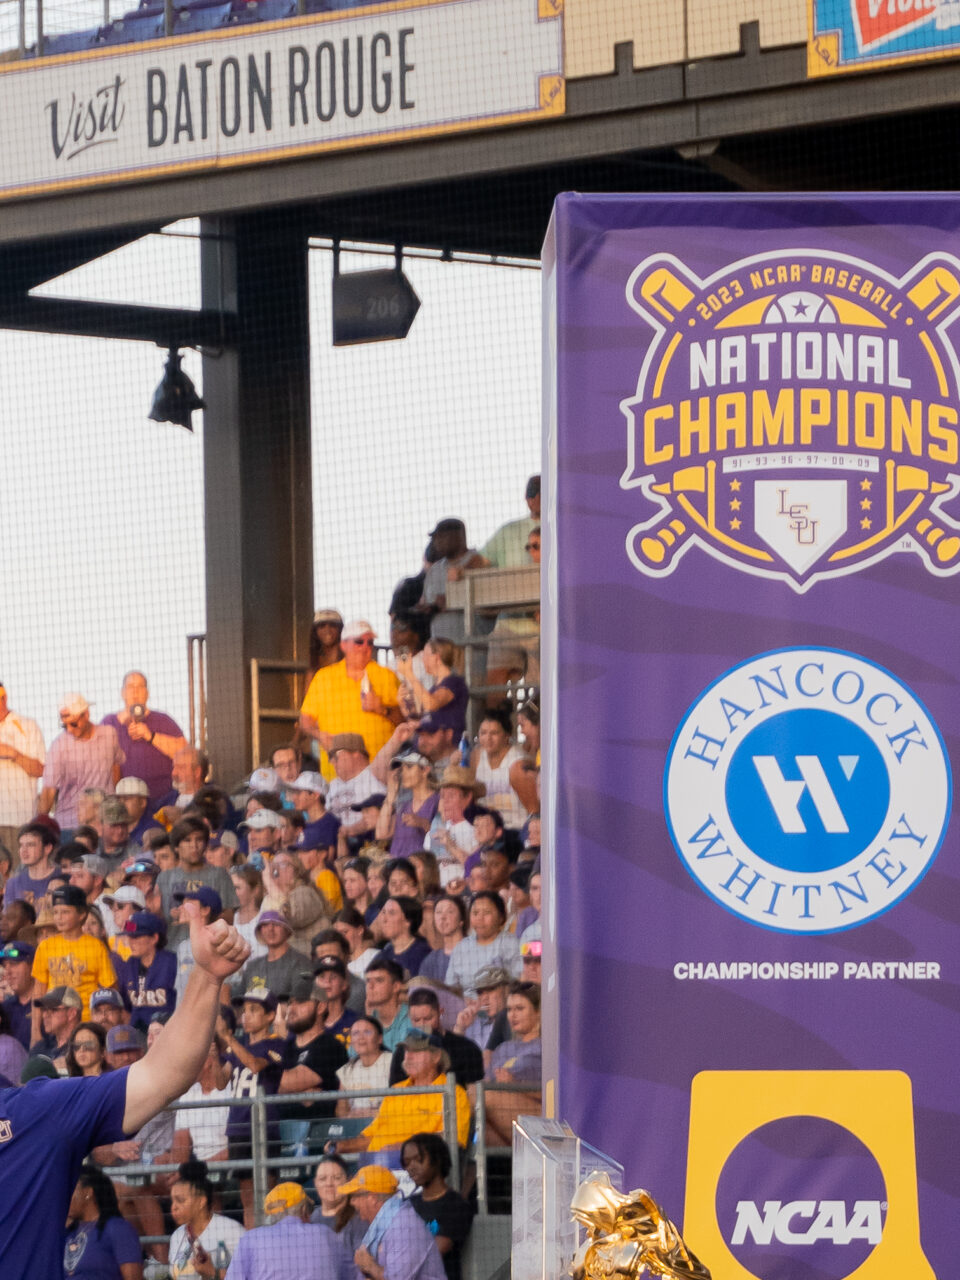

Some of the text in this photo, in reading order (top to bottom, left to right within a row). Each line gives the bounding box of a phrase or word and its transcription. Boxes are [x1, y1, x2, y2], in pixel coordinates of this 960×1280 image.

[44, 27, 415, 161] Visit BATON ROUGE
[696, 279, 745, 321] 2023
[810, 264, 904, 319] BASEBALL
[689, 331, 912, 390] NATIONAL
[643, 387, 959, 466] CHAMPIONS
[778, 488, 819, 545] LSU
[683, 662, 929, 771] HANCOCK
[687, 812, 928, 919] WHITNEY
[673, 962, 941, 980] CHAMPIONSHIP PARTNER
